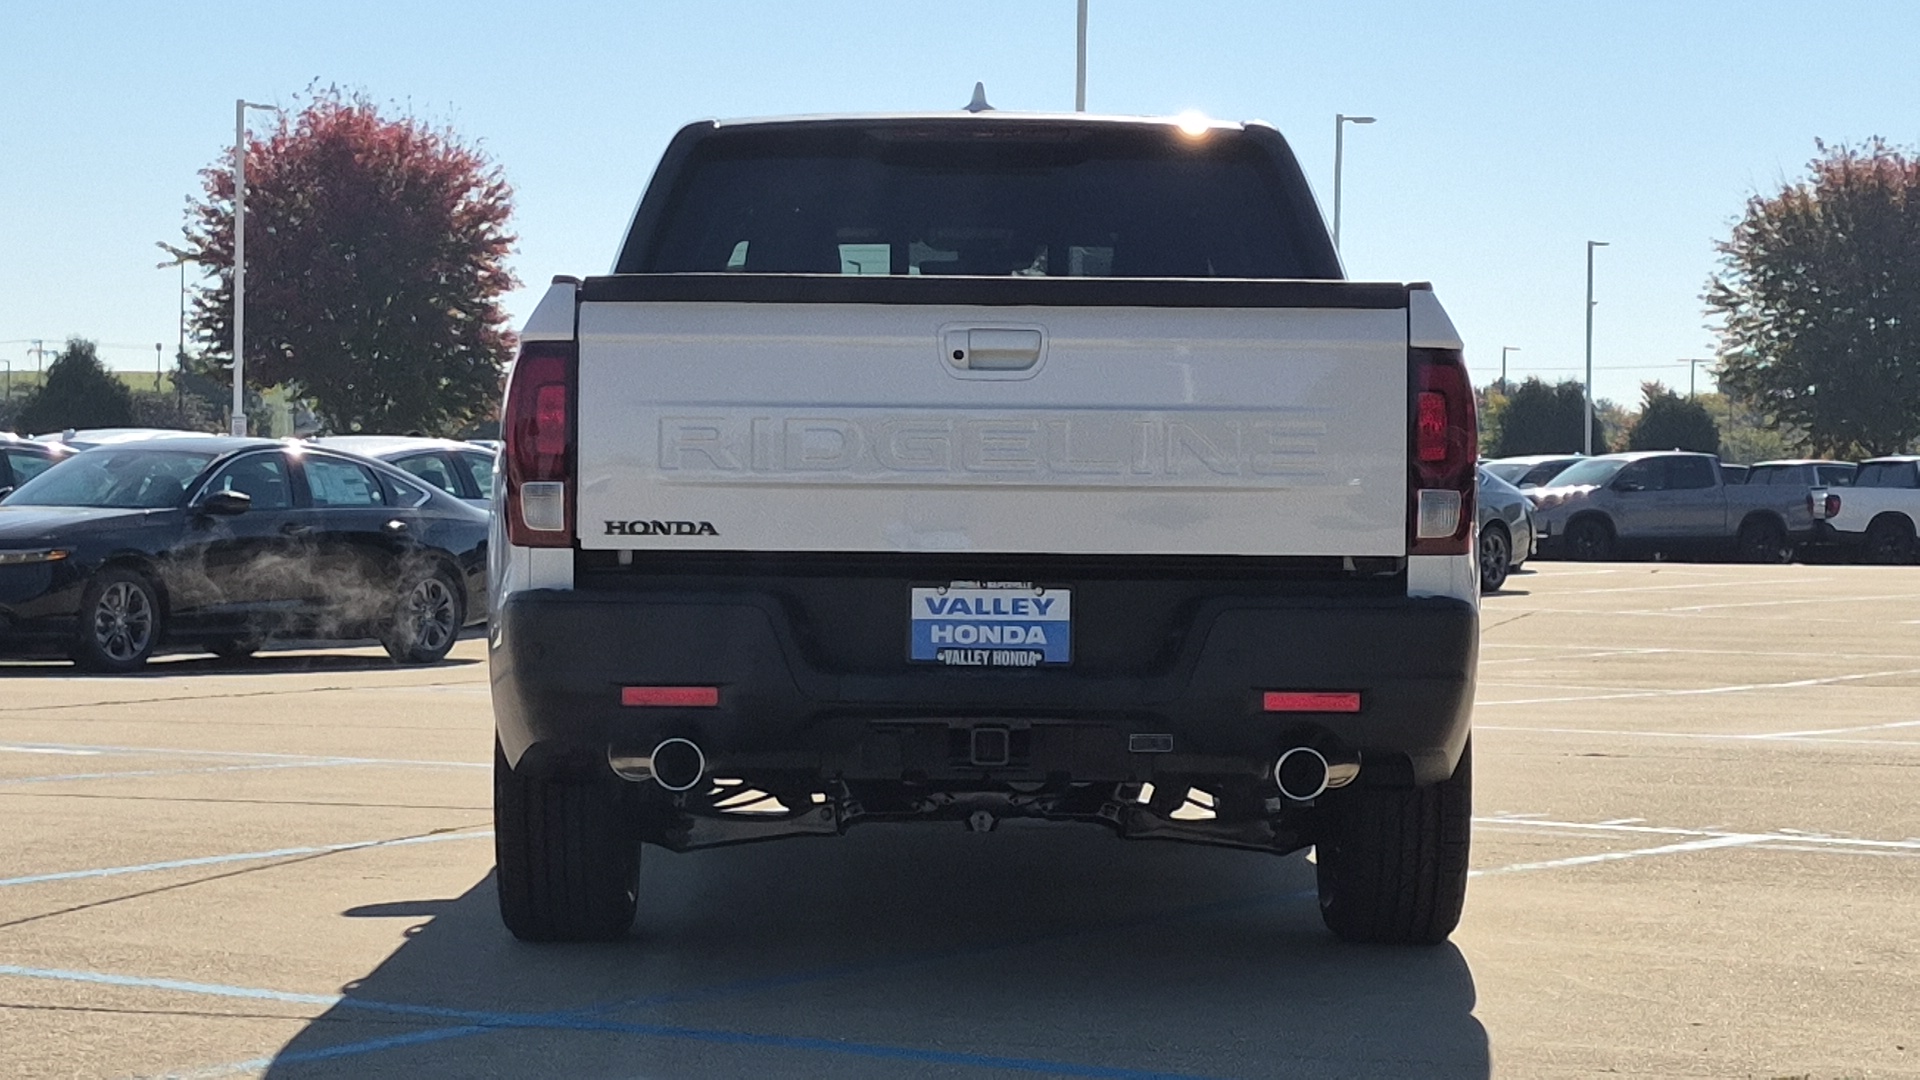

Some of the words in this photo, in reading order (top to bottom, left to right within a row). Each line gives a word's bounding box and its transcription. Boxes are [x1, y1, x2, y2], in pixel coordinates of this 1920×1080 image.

[658, 416, 1326, 475] RIDGELINE
[604, 520, 719, 535] HONDA
[925, 597, 1055, 615] VALLEY
[931, 625, 1048, 644] HONDA
[944, 649, 990, 665] VALLEY
[992, 650, 1037, 666] HONDA
